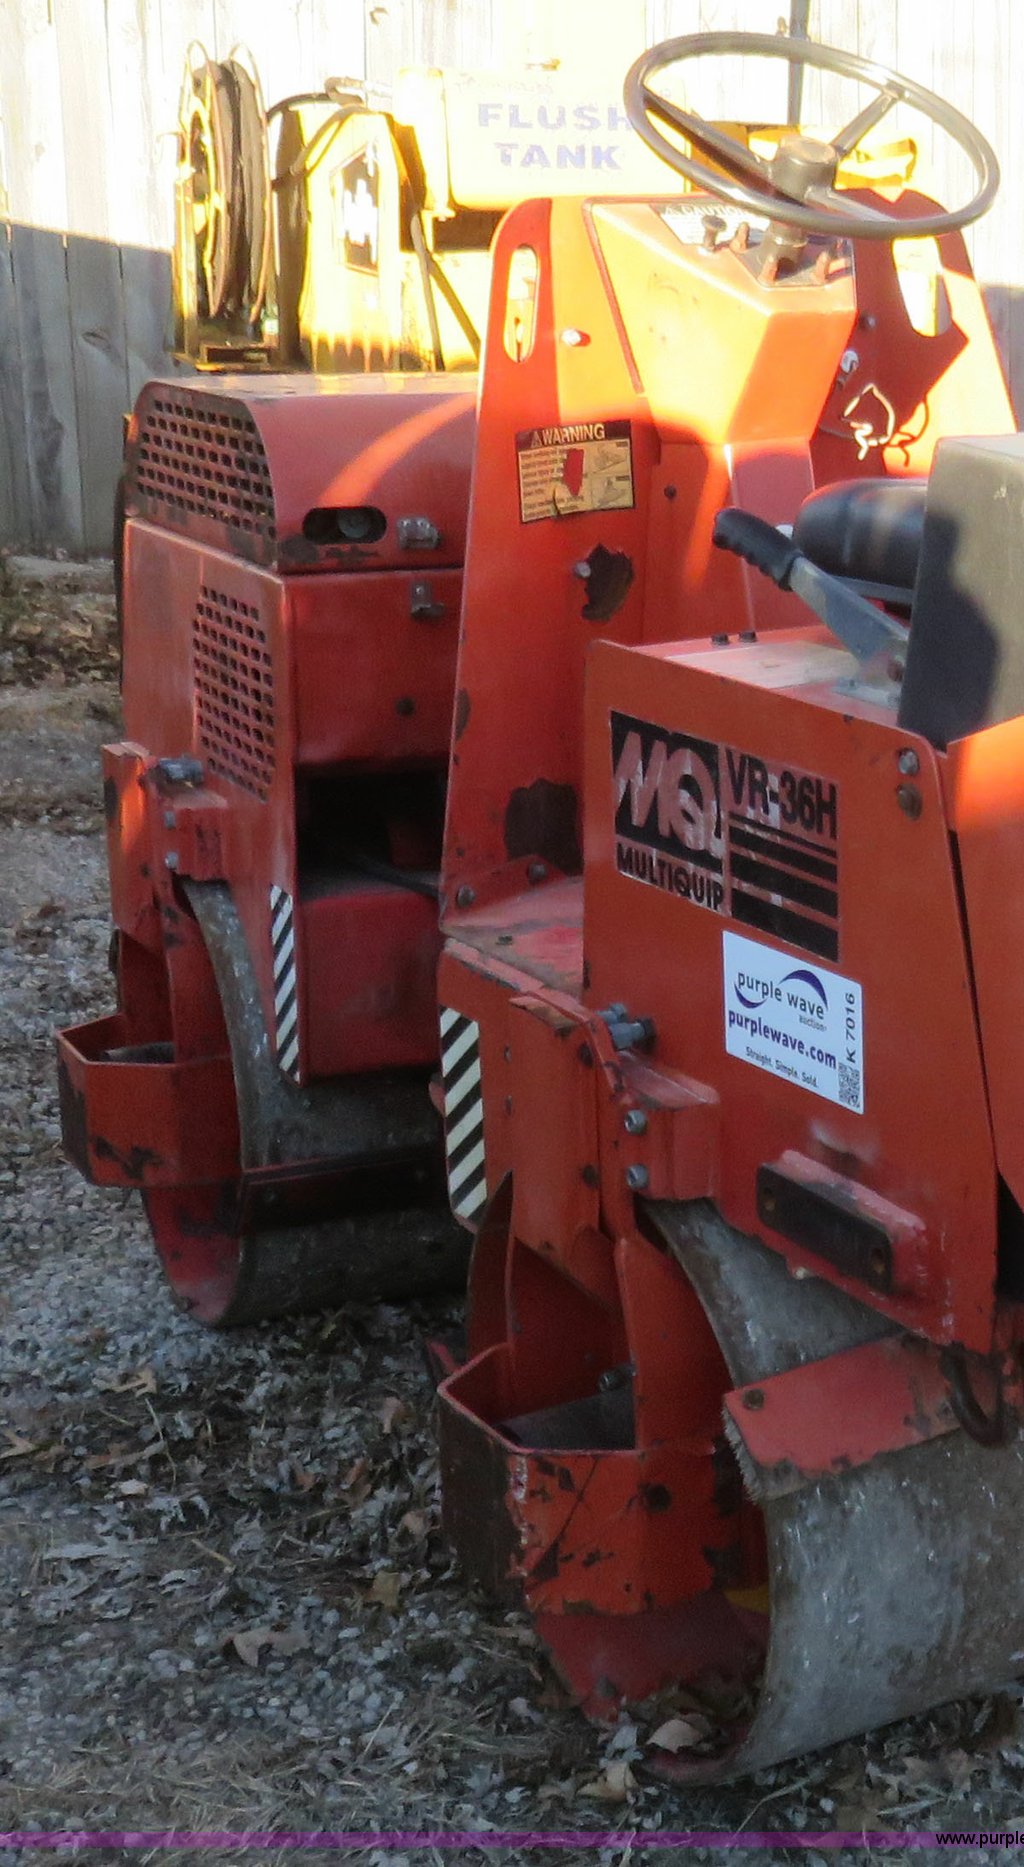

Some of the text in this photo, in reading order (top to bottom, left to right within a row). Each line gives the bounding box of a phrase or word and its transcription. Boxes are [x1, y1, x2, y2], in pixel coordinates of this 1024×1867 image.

[477, 102, 633, 131] FLUSH
[493, 142, 622, 170] TANK
[541, 423, 605, 447] WARNING
[726, 750, 838, 840] VR-36H
[617, 843, 724, 911] MULTIQUIP
[737, 972, 824, 1020] purple wave
[728, 1010, 837, 1070] purplewave.com
[845, 993, 856, 1063] K 7016
